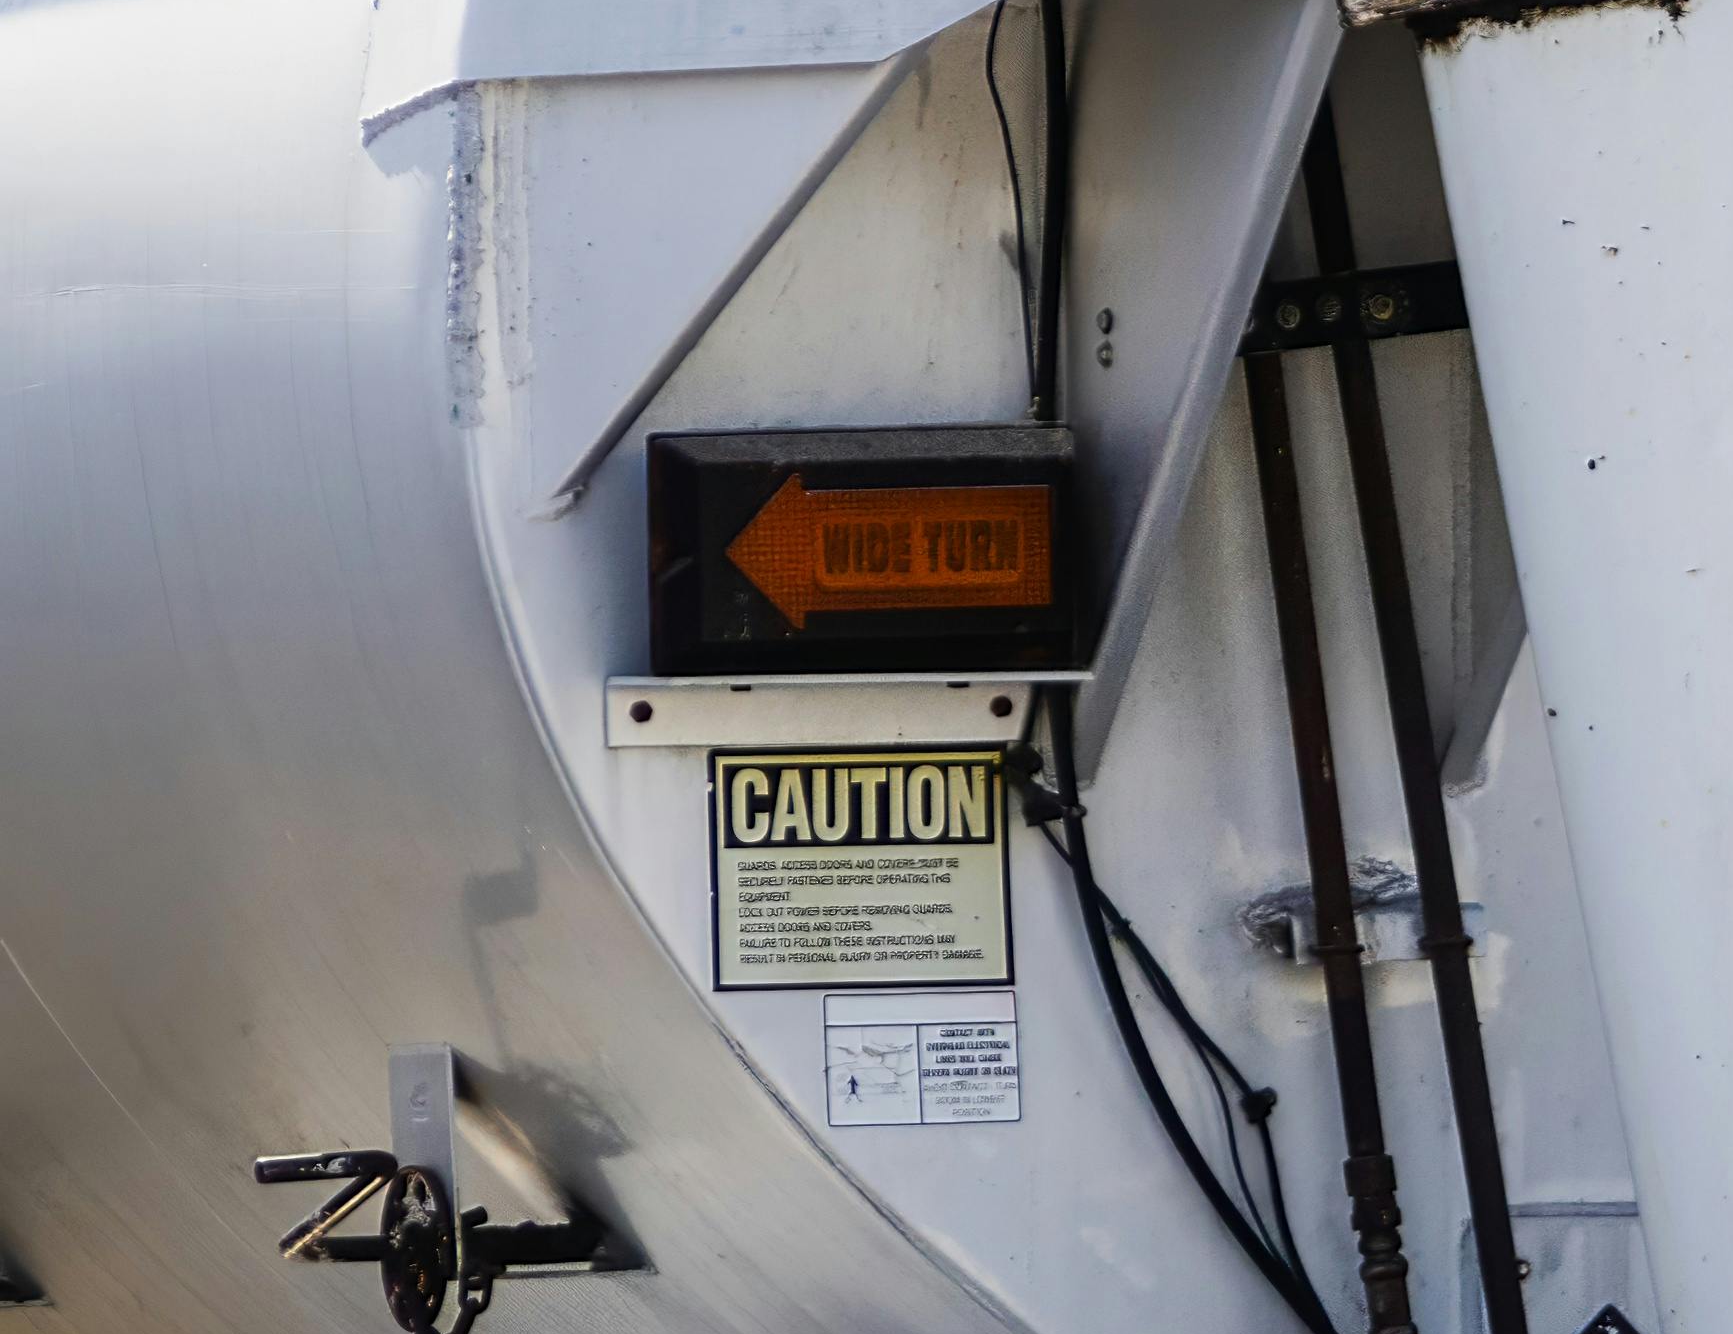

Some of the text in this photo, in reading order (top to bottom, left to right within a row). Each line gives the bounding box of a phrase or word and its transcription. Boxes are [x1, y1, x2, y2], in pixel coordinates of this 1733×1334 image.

[822, 519, 1019, 574] WIDE TURN
[731, 765, 987, 843] CAUTION
